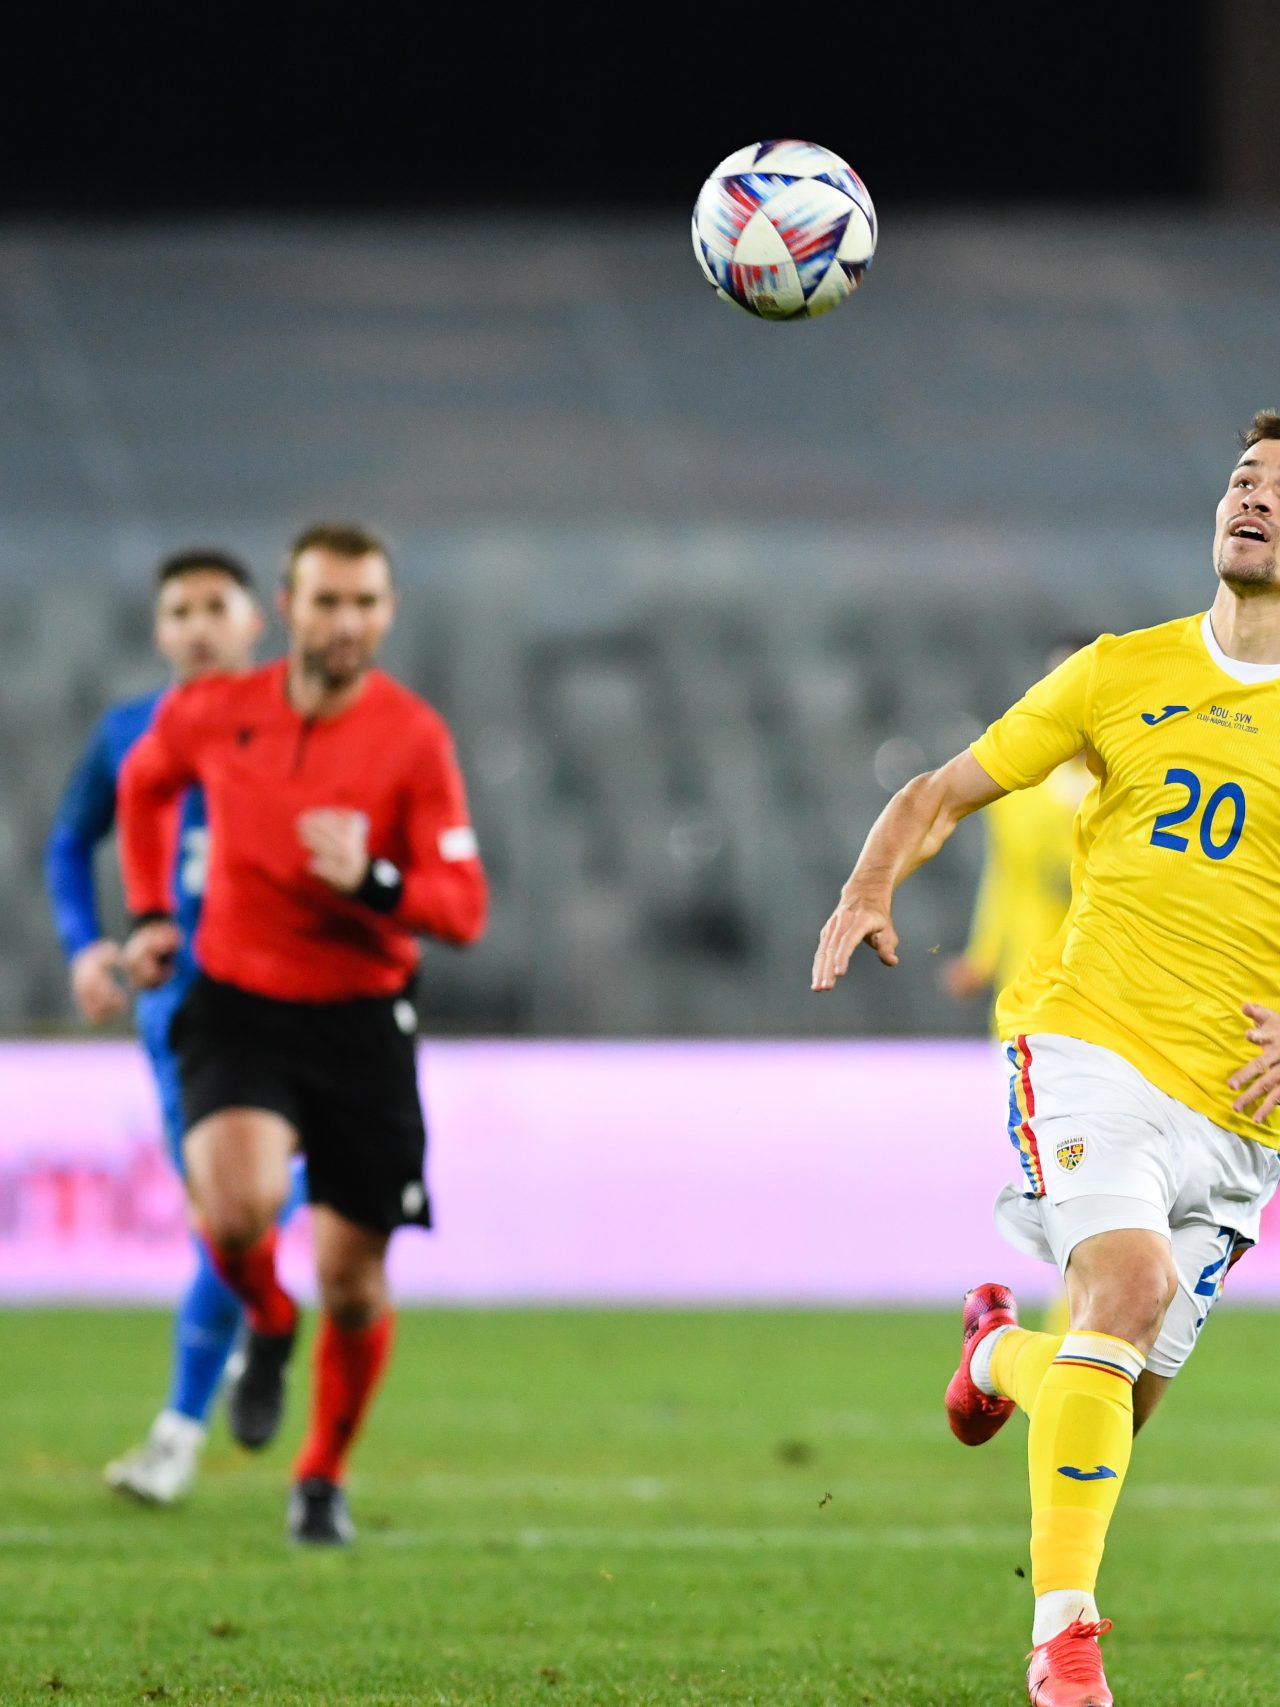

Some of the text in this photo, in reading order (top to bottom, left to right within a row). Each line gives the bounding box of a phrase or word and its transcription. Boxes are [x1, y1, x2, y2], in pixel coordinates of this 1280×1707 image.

[1210, 705, 1229, 719] ROU
[1234, 712, 1252, 724] SVN
[1150, 768, 1246, 861] 20
